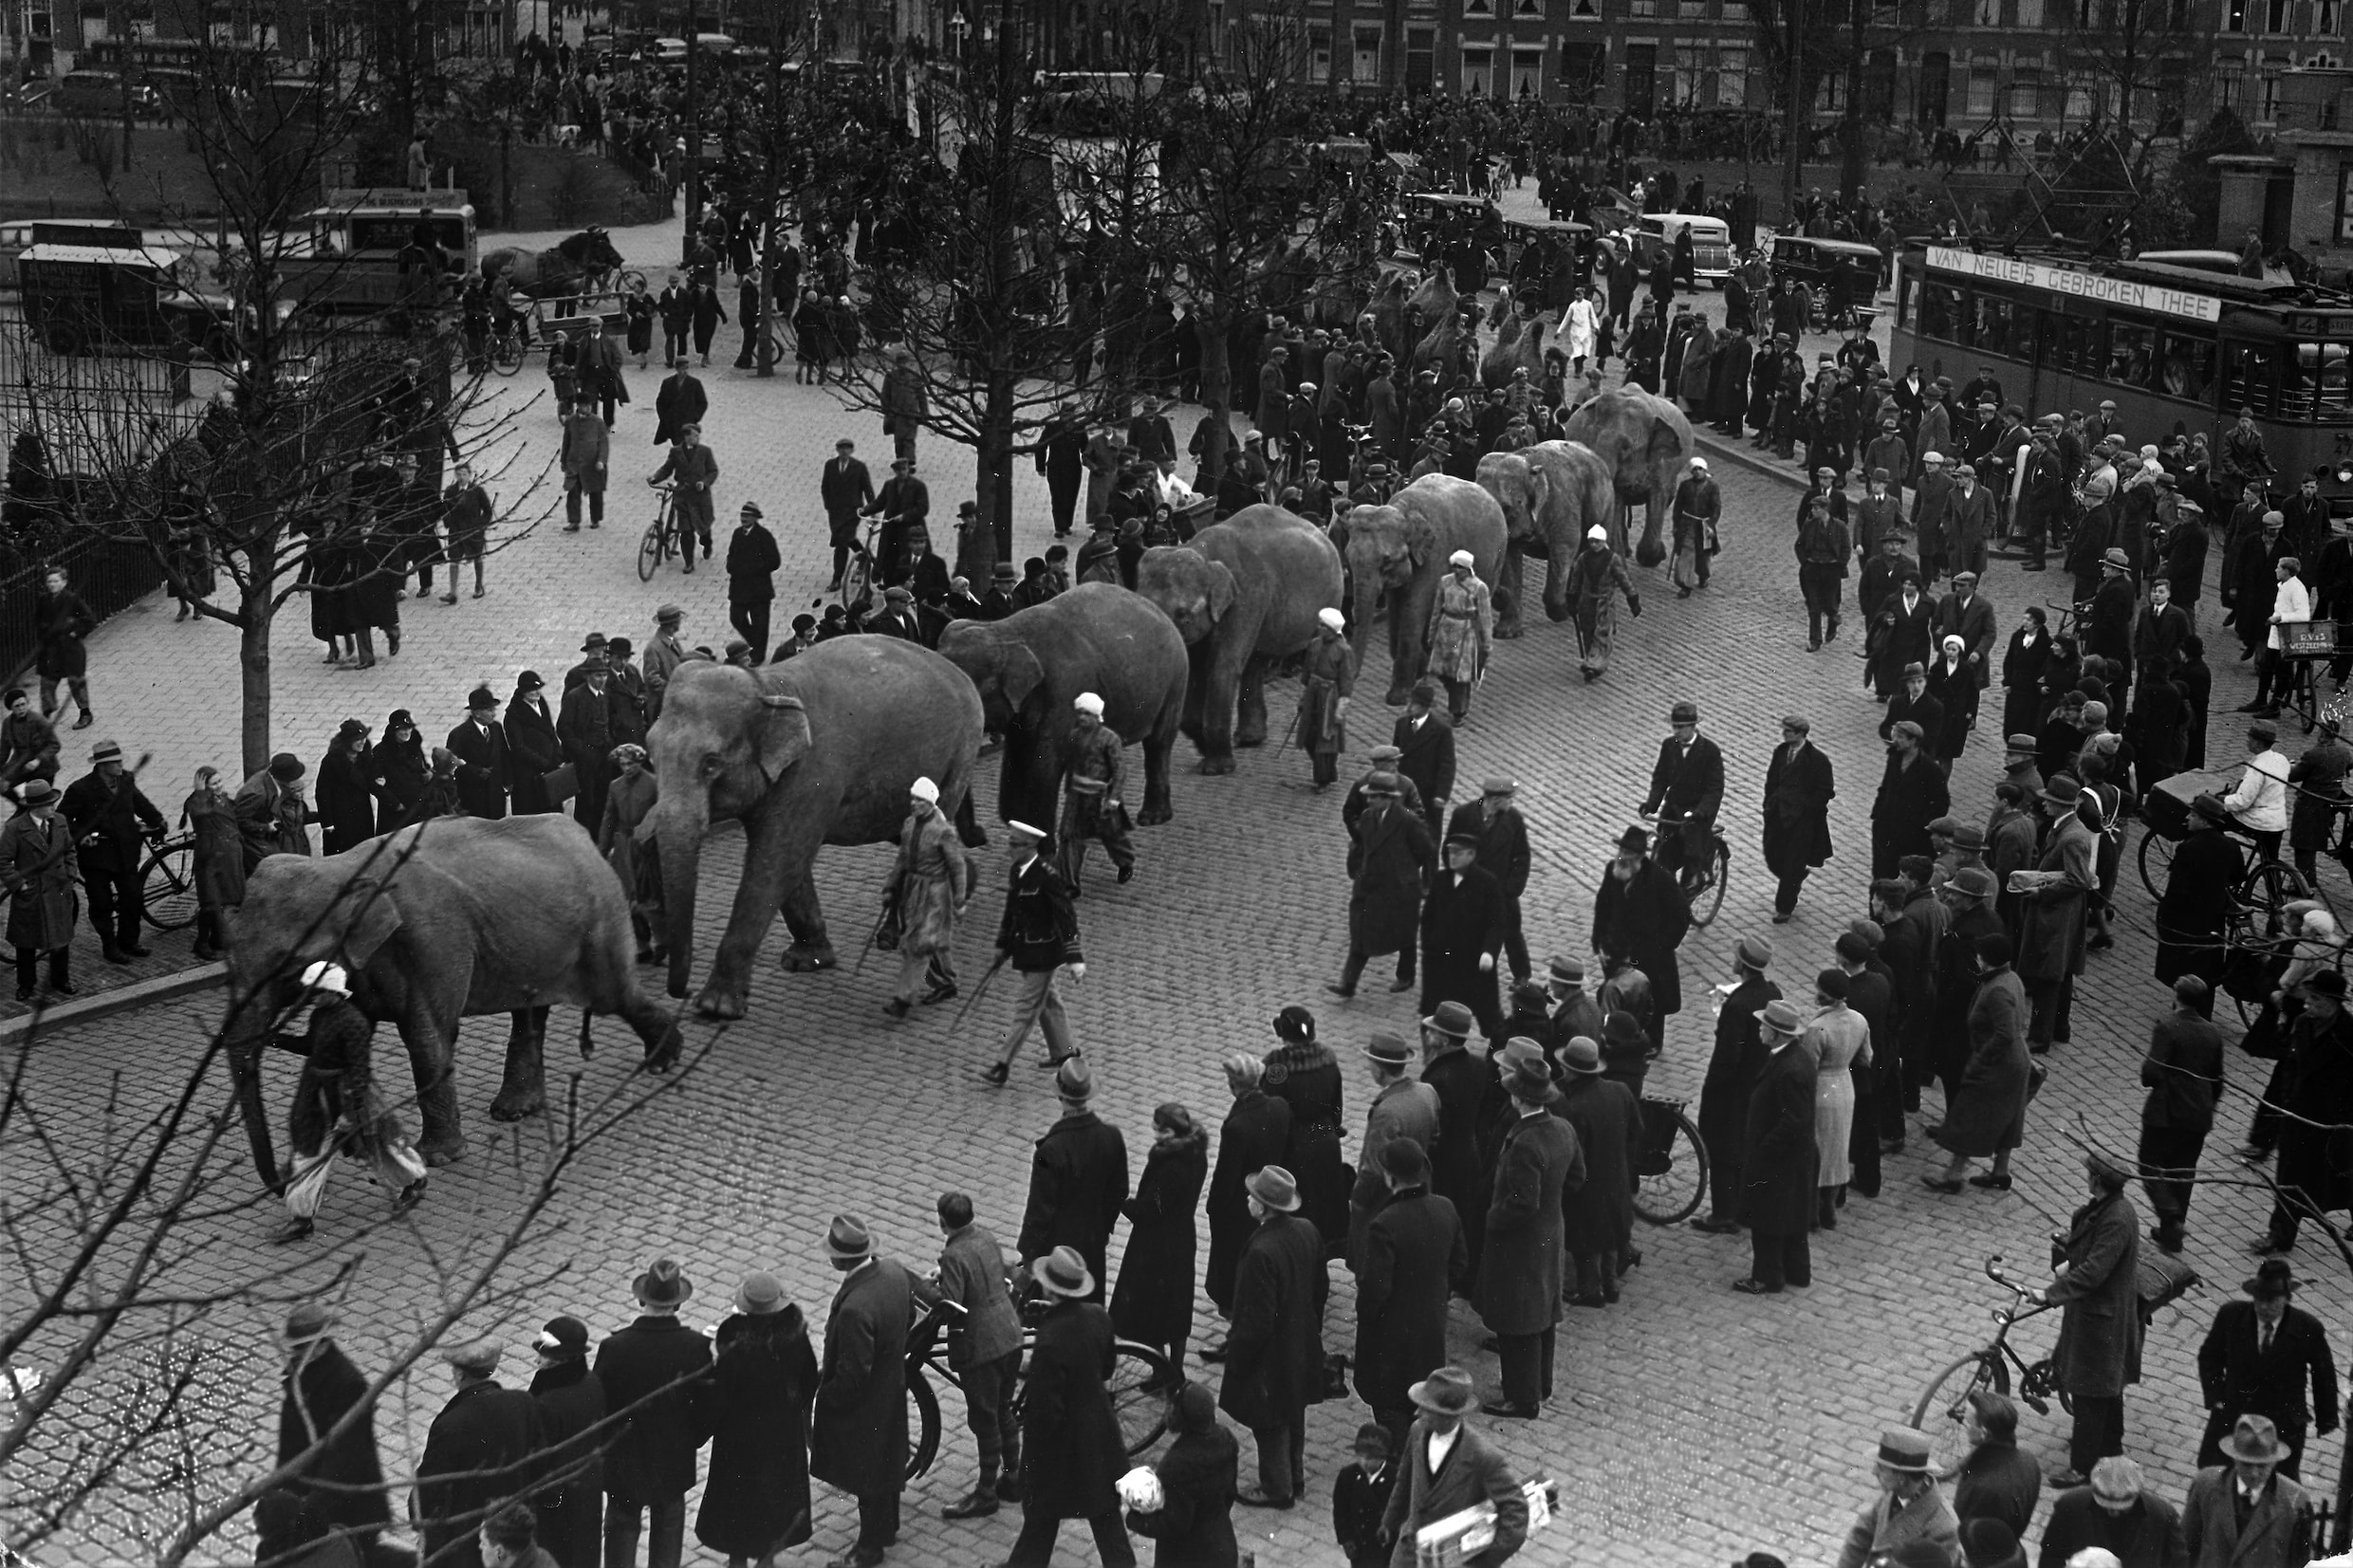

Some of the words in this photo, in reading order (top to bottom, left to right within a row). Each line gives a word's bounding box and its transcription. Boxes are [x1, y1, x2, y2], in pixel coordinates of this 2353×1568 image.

[1935, 249, 1962, 269] VAN
[2048, 270, 2146, 308] GEBROKEN
[2161, 291, 2210, 318] THEE
[2299, 318, 2316, 332] 4
